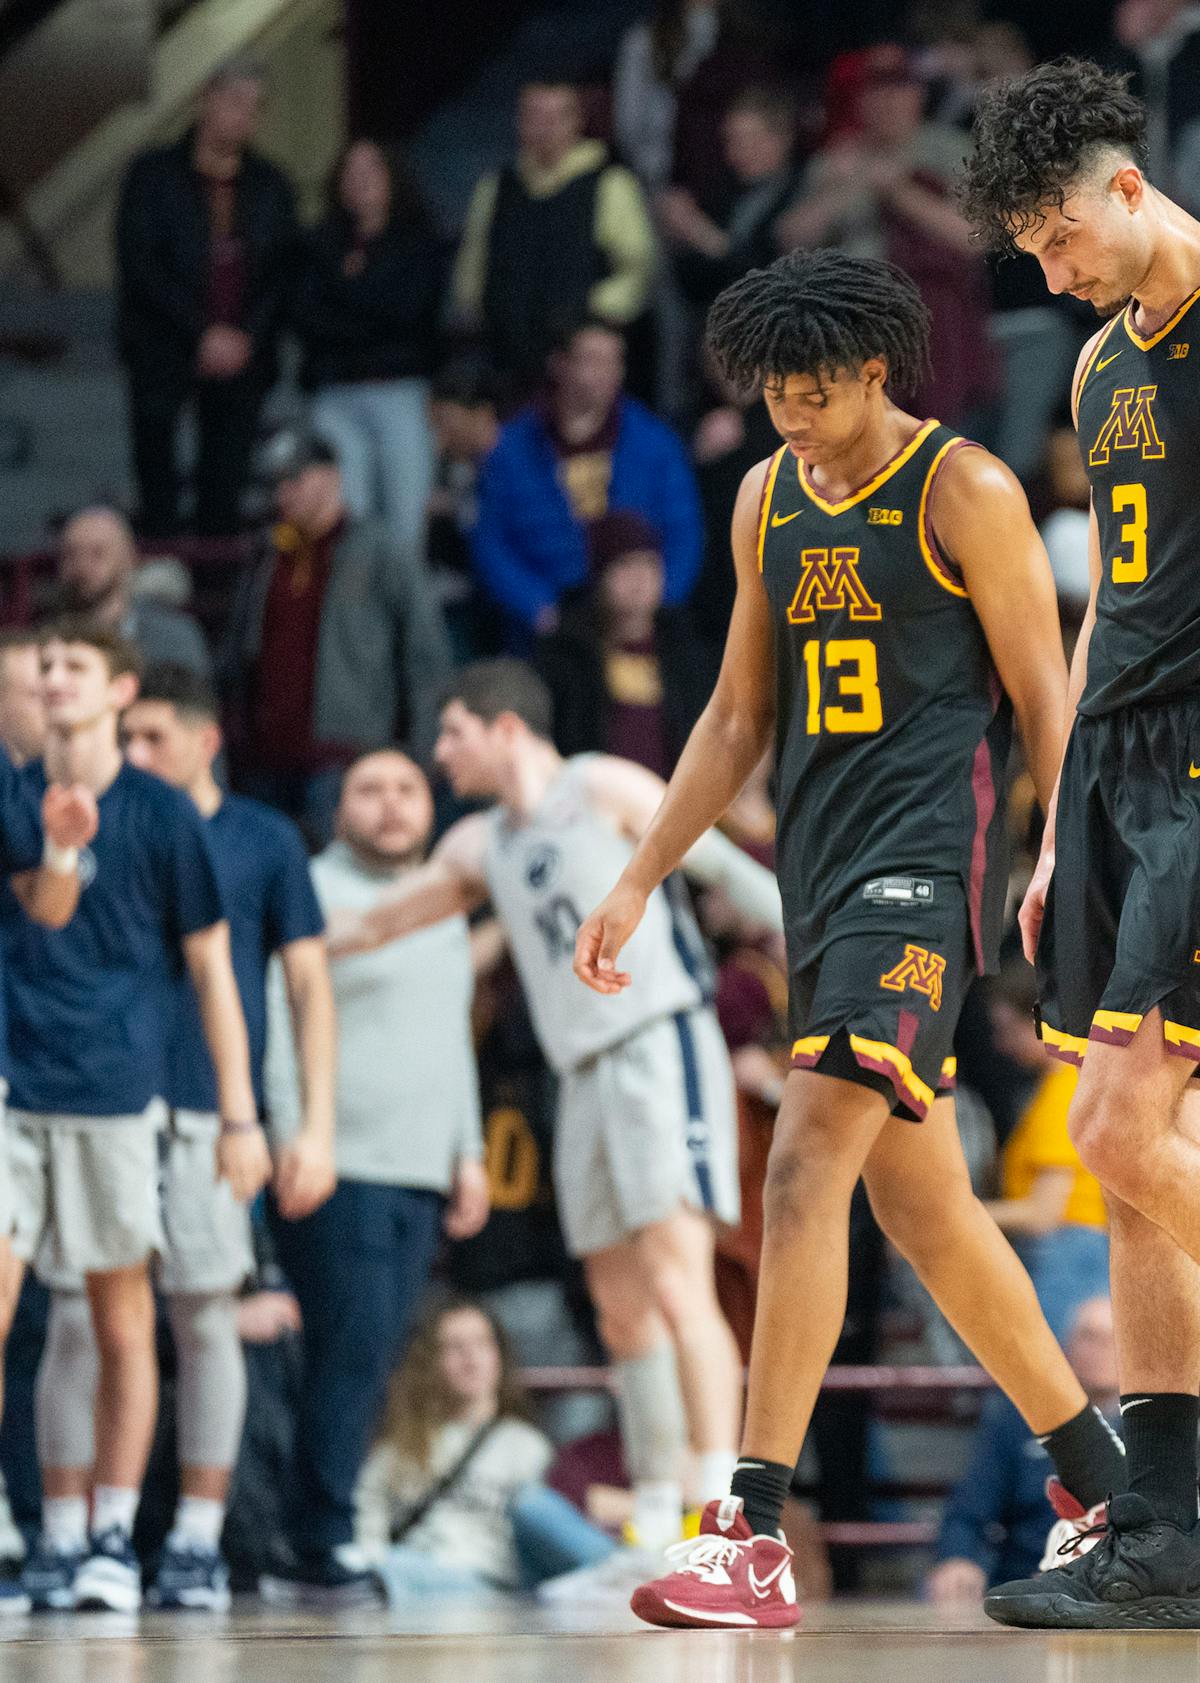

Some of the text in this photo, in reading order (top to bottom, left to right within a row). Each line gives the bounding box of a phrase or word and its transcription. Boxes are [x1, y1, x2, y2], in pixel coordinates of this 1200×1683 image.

[1089, 385, 1166, 467] M
[1112, 483, 1148, 584] 3
[786, 547, 883, 625] M
[803, 639, 884, 736] 13
[880, 944, 947, 1012] M
